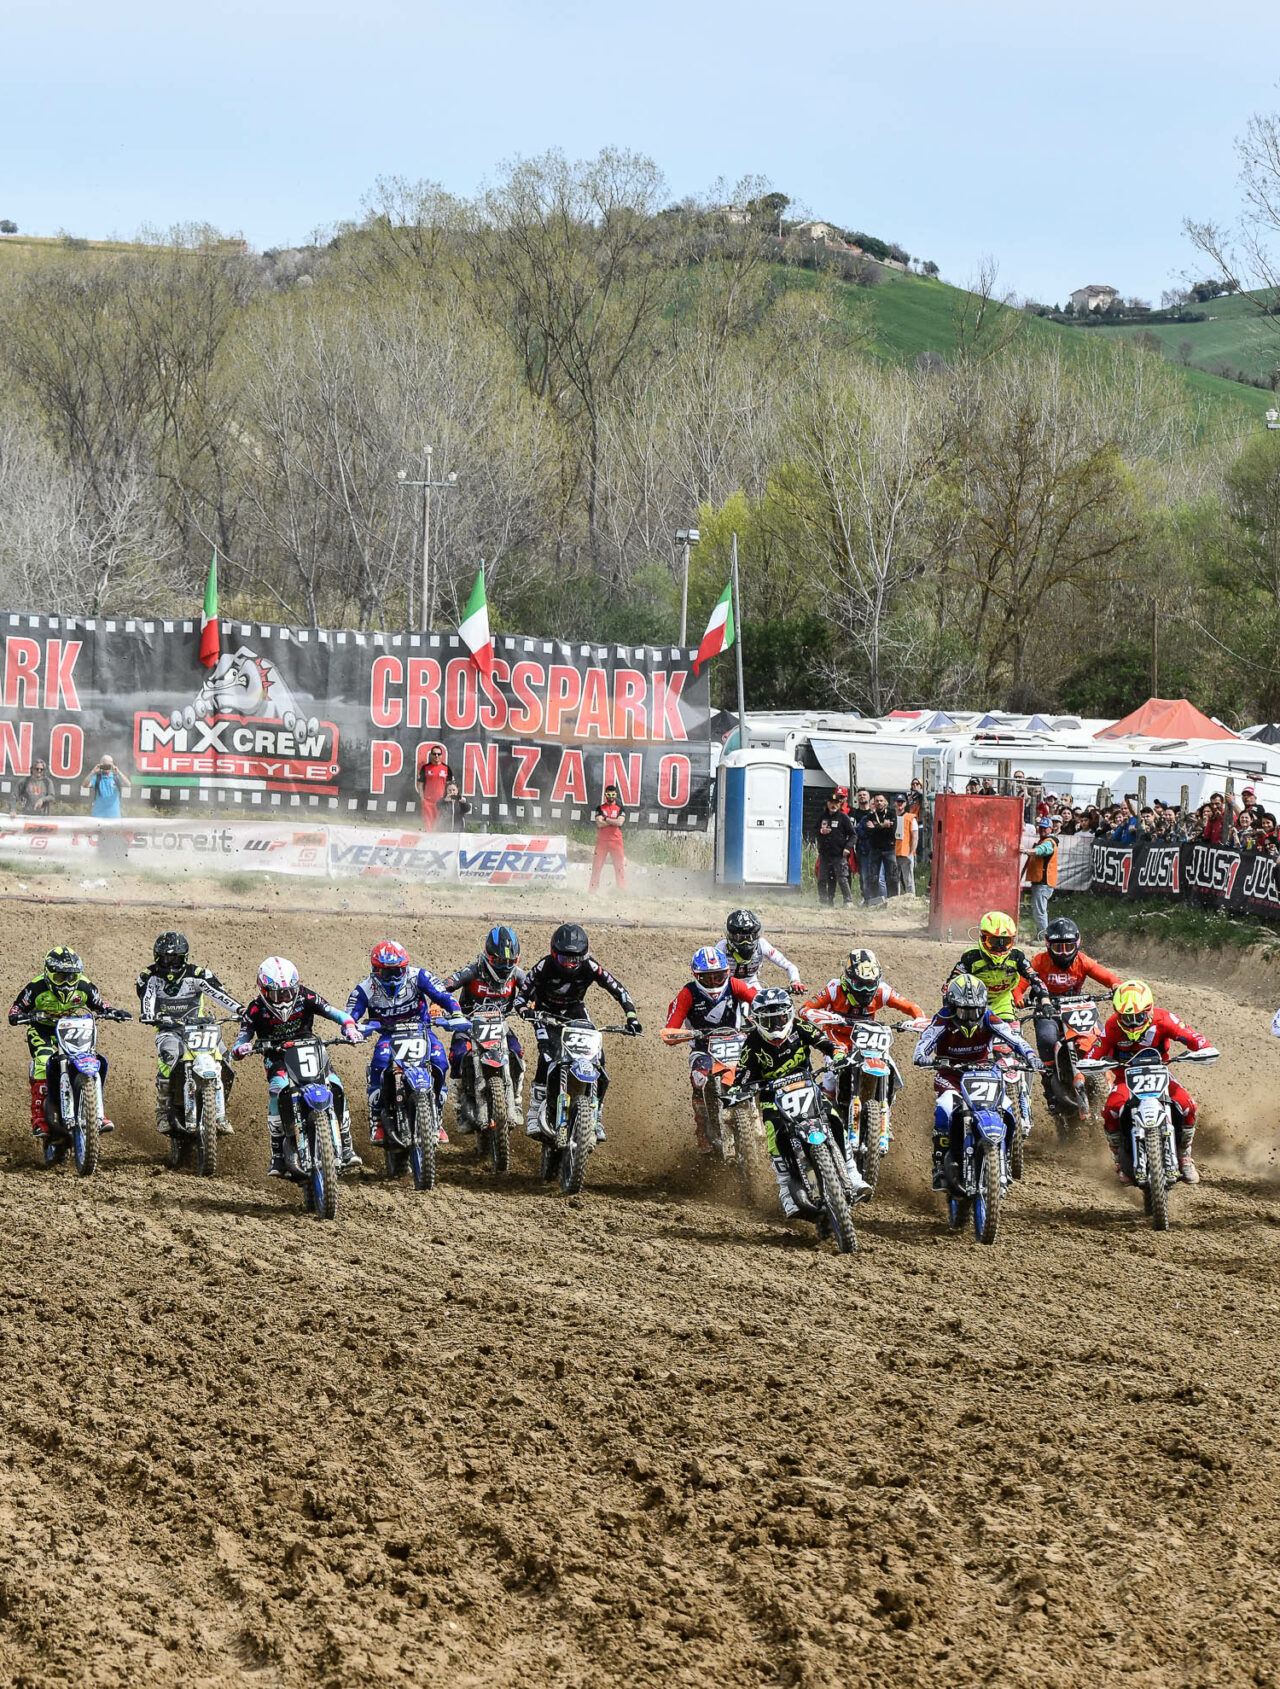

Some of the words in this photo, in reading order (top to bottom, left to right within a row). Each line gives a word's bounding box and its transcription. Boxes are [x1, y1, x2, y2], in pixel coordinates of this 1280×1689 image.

[370, 655, 689, 741] CROSSPARK
[140, 719, 230, 753] MX
[232, 728, 326, 757] CREW
[140, 757, 329, 780] LIFESTYLE
[330, 844, 454, 870] VERTEX
[1068, 1010, 1095, 1026] 42
[188, 1031, 218, 1049] 511
[478, 1024, 502, 1040] 72
[855, 1032, 890, 1051] 240
[394, 1039, 427, 1060] 79
[297, 1047, 318, 1077] 5
[969, 1081, 998, 1102] 21
[1132, 1074, 1166, 1093] 237
[781, 1086, 815, 1118] 97
